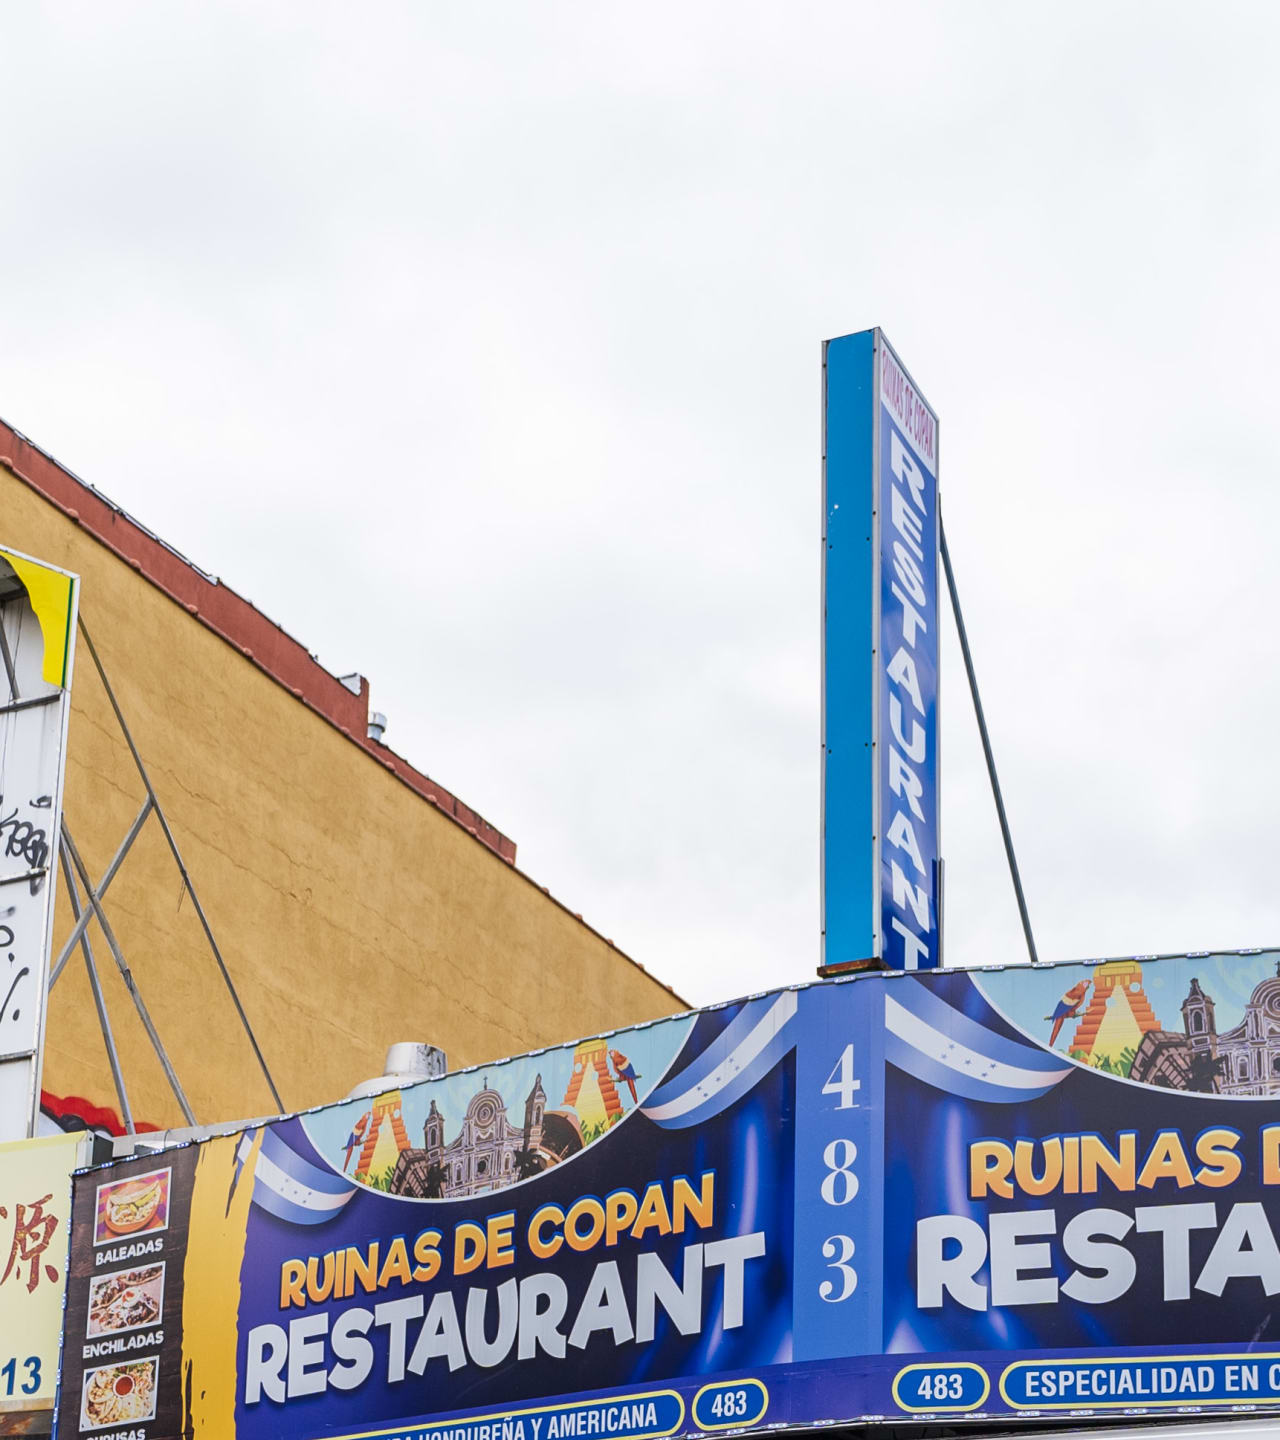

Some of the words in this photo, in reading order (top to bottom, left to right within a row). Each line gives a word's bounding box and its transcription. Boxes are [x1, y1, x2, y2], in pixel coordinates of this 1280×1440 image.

[887, 430, 929, 971] RESTAURANT
[968, 1124, 1244, 1199] RUINAS
[95, 1238, 163, 1266] BALEADAS
[279, 1230, 443, 1309] RUINAS
[453, 1210, 516, 1276] DE
[528, 1169, 716, 1260] COPAN
[245, 1231, 766, 1405] RESTAURANT
[82, 1330, 164, 1359] ENCHILADAS
[917, 1374, 963, 1400] 483
[1025, 1364, 1215, 1397] ESPECIALIDAD
[1225, 1364, 1259, 1392] EN
[530, 1418, 544, 1438] Y
[547, 1402, 658, 1436] AMERICANA
[711, 1391, 747, 1418] 483
